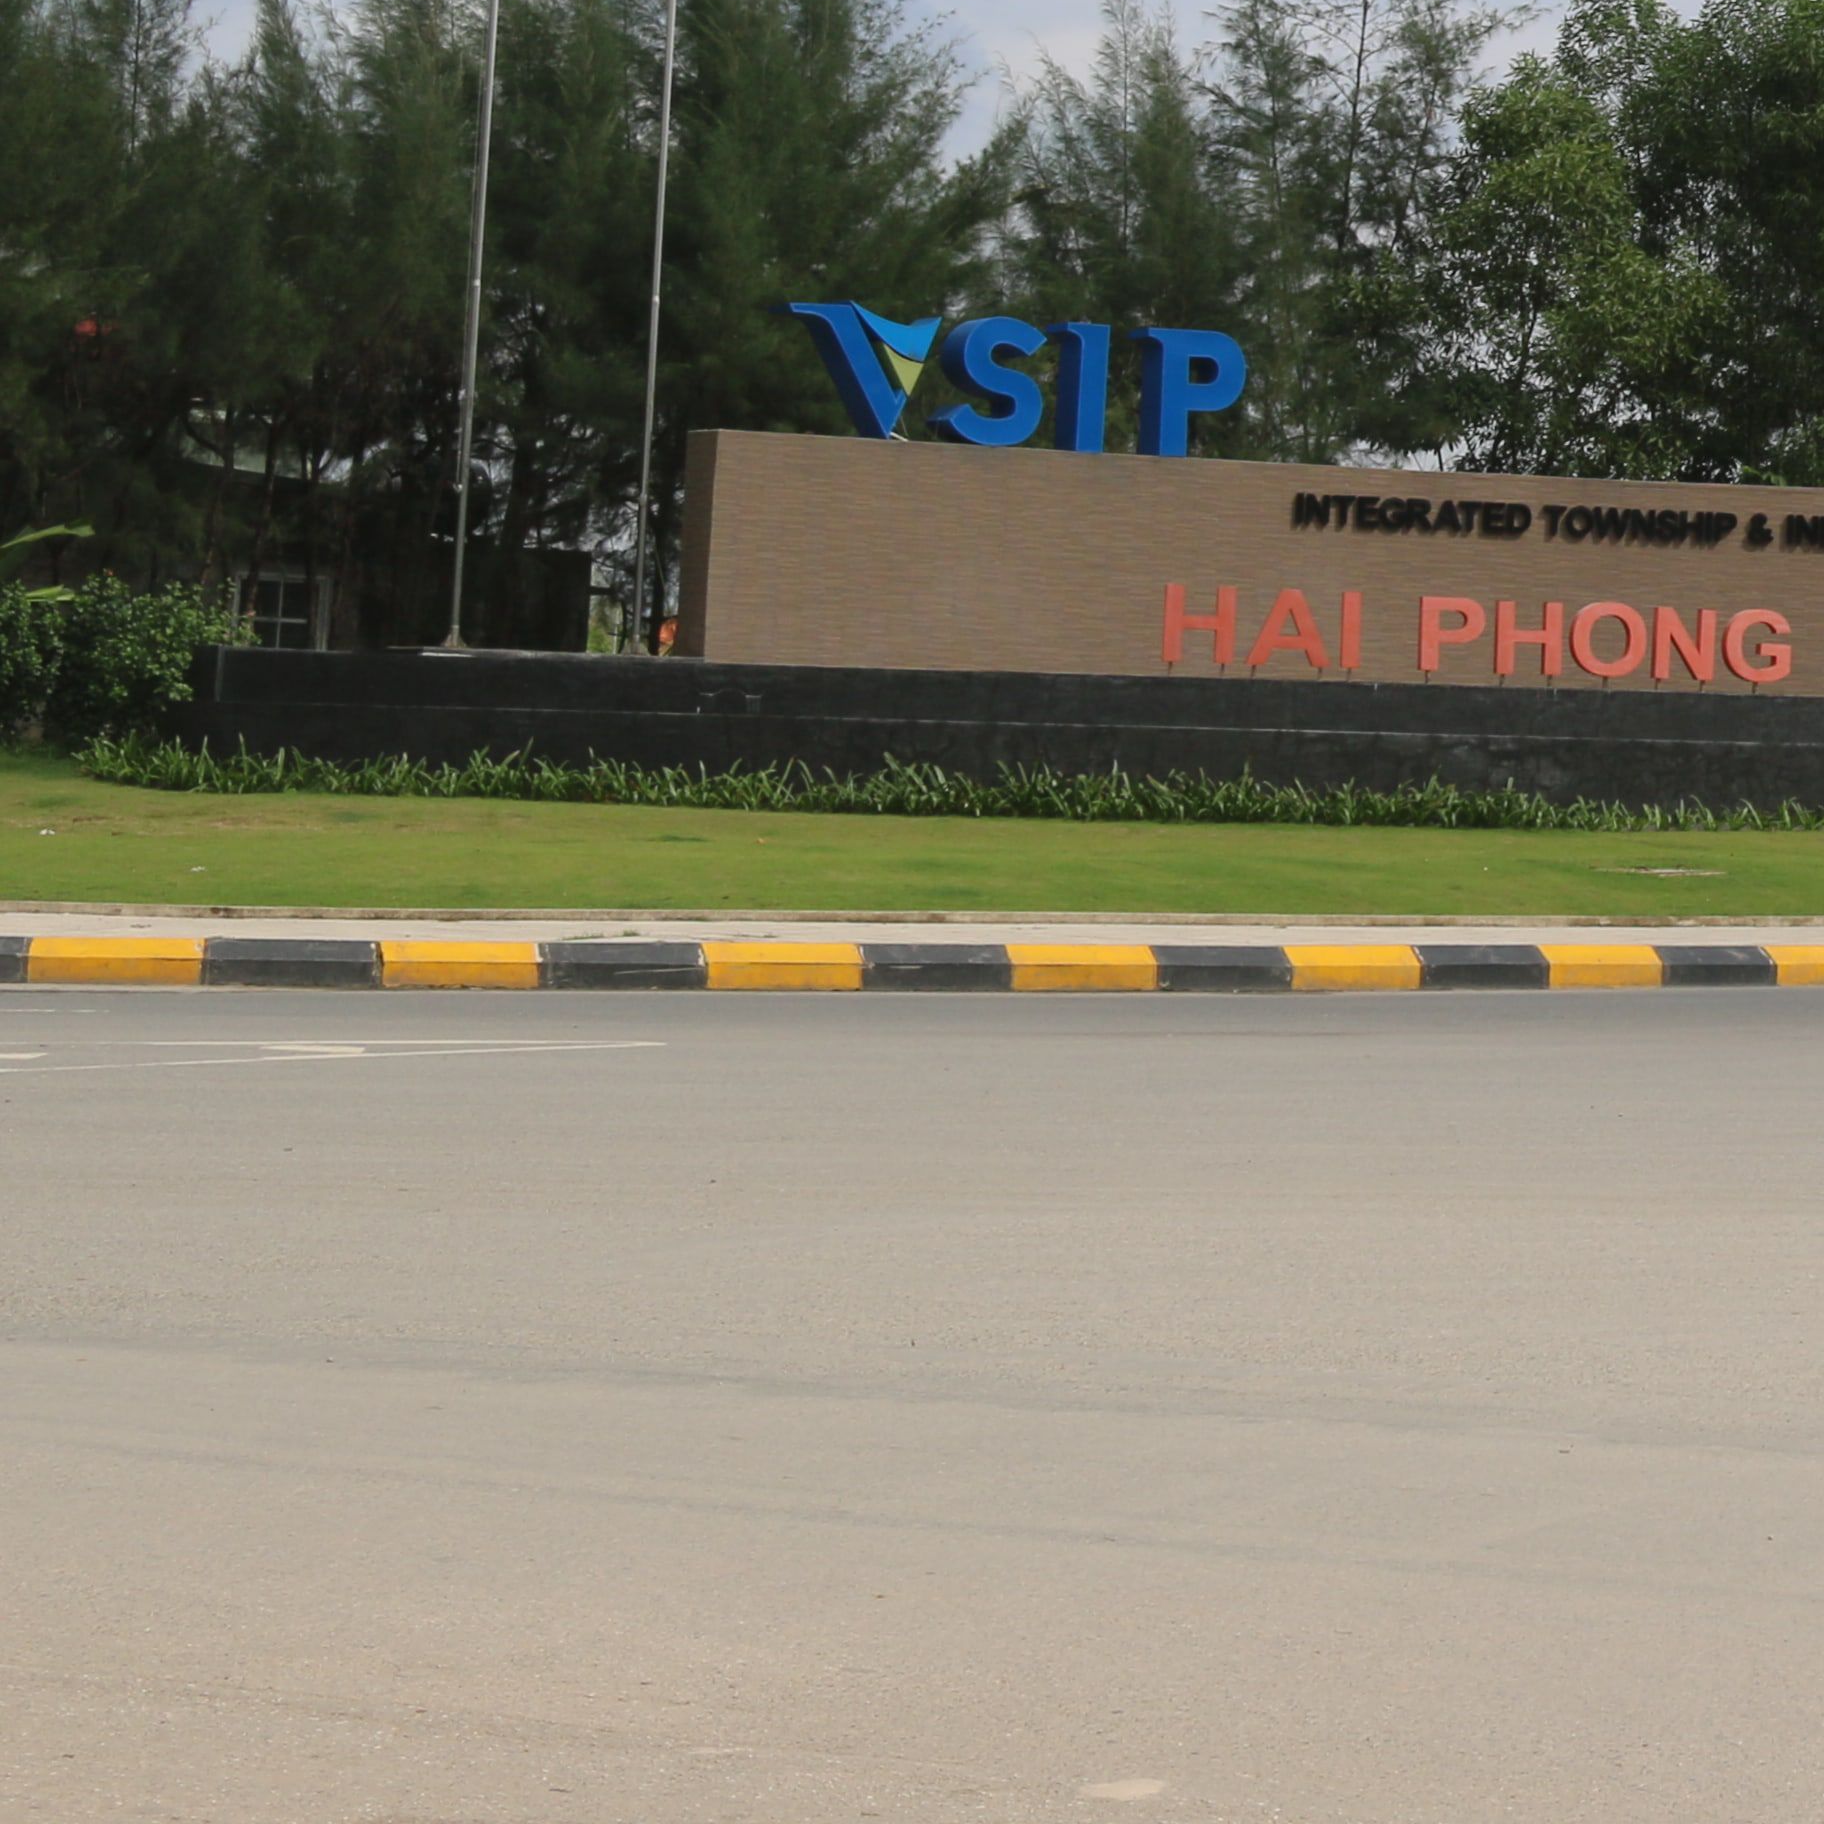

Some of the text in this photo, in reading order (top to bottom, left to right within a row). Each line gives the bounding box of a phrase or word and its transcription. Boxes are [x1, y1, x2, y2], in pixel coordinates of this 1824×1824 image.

[772, 300, 1247, 457] VSIP
[1293, 492, 1532, 536] INTEGRATED
[1541, 504, 1738, 546] TOWNSHIP
[1746, 513, 1774, 549] &
[1163, 583, 1363, 669] HAI
[1418, 594, 1793, 683] PHONG
